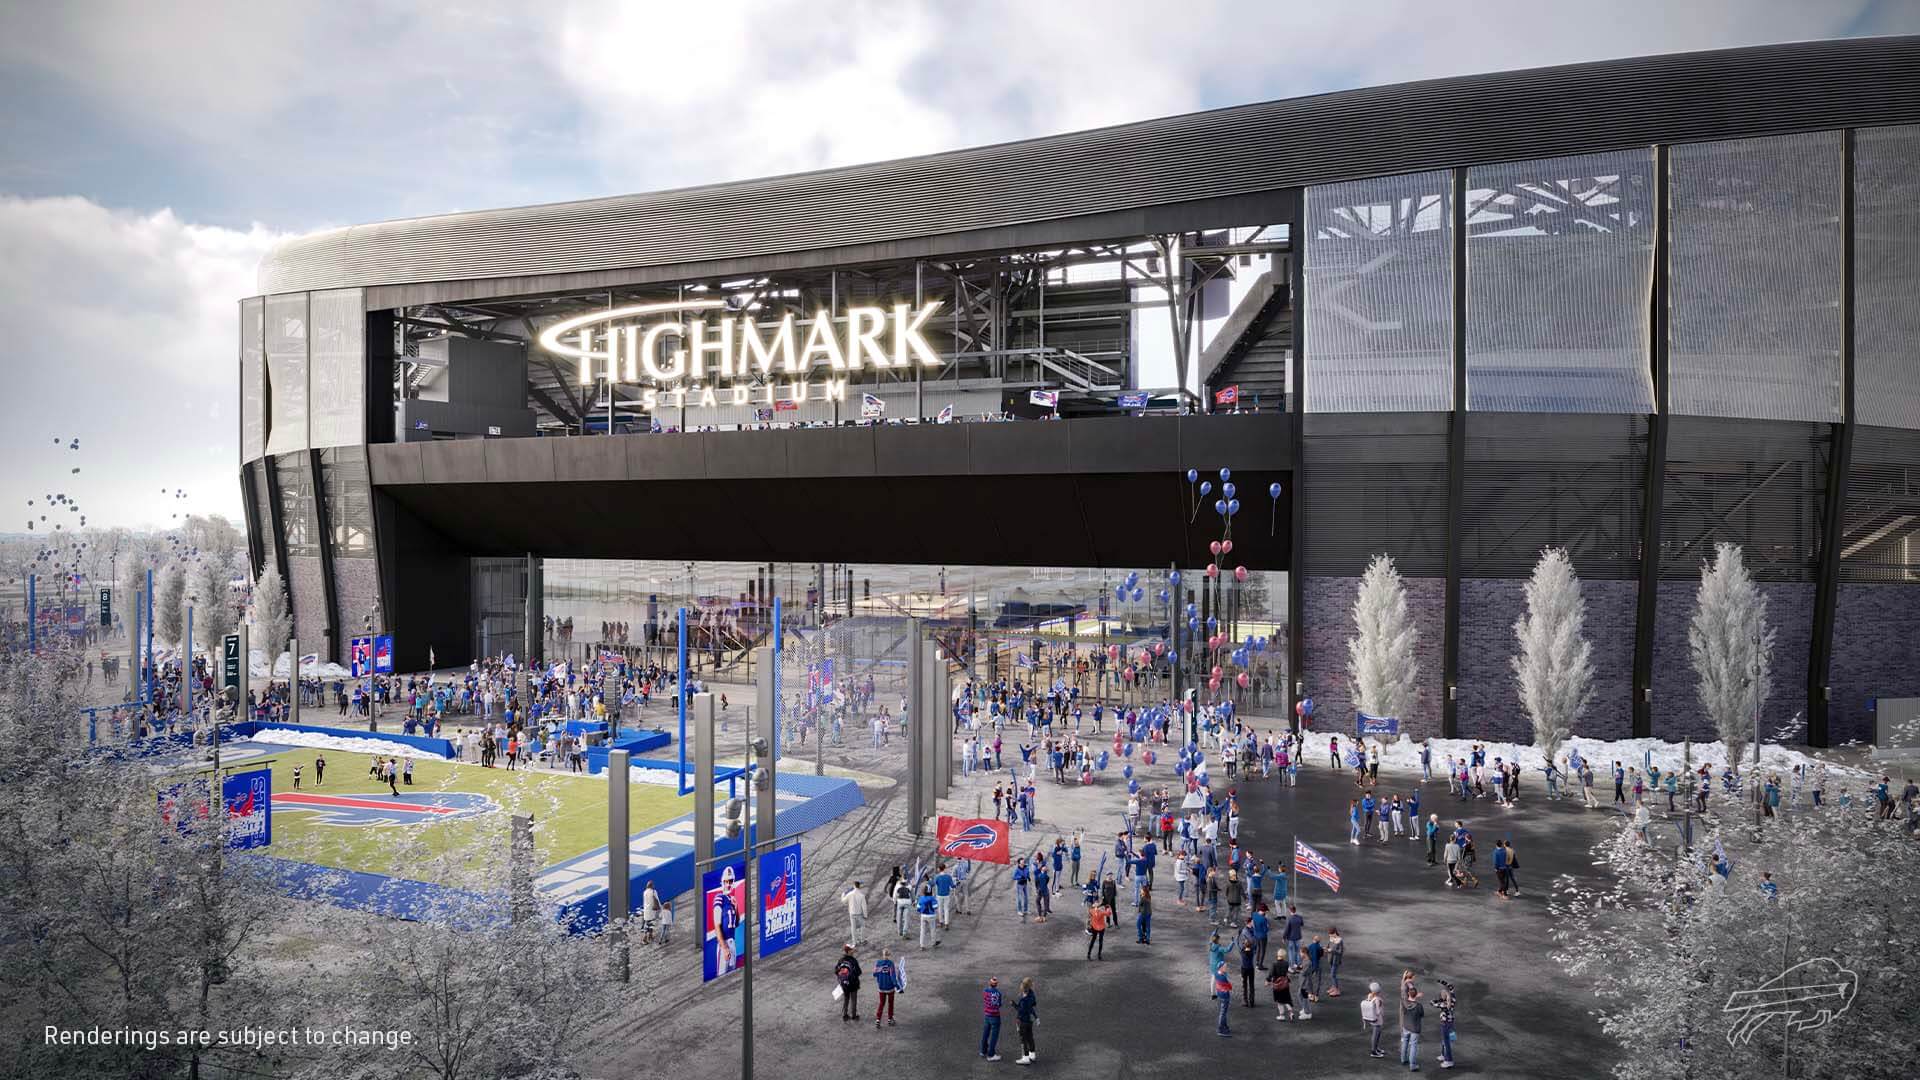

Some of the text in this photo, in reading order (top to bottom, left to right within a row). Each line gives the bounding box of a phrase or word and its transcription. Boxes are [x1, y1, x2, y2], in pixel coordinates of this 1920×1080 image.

[540, 301, 945, 384] HIGHMARK
[642, 379, 845, 410] STADIUM
[228, 642, 236, 655] 7
